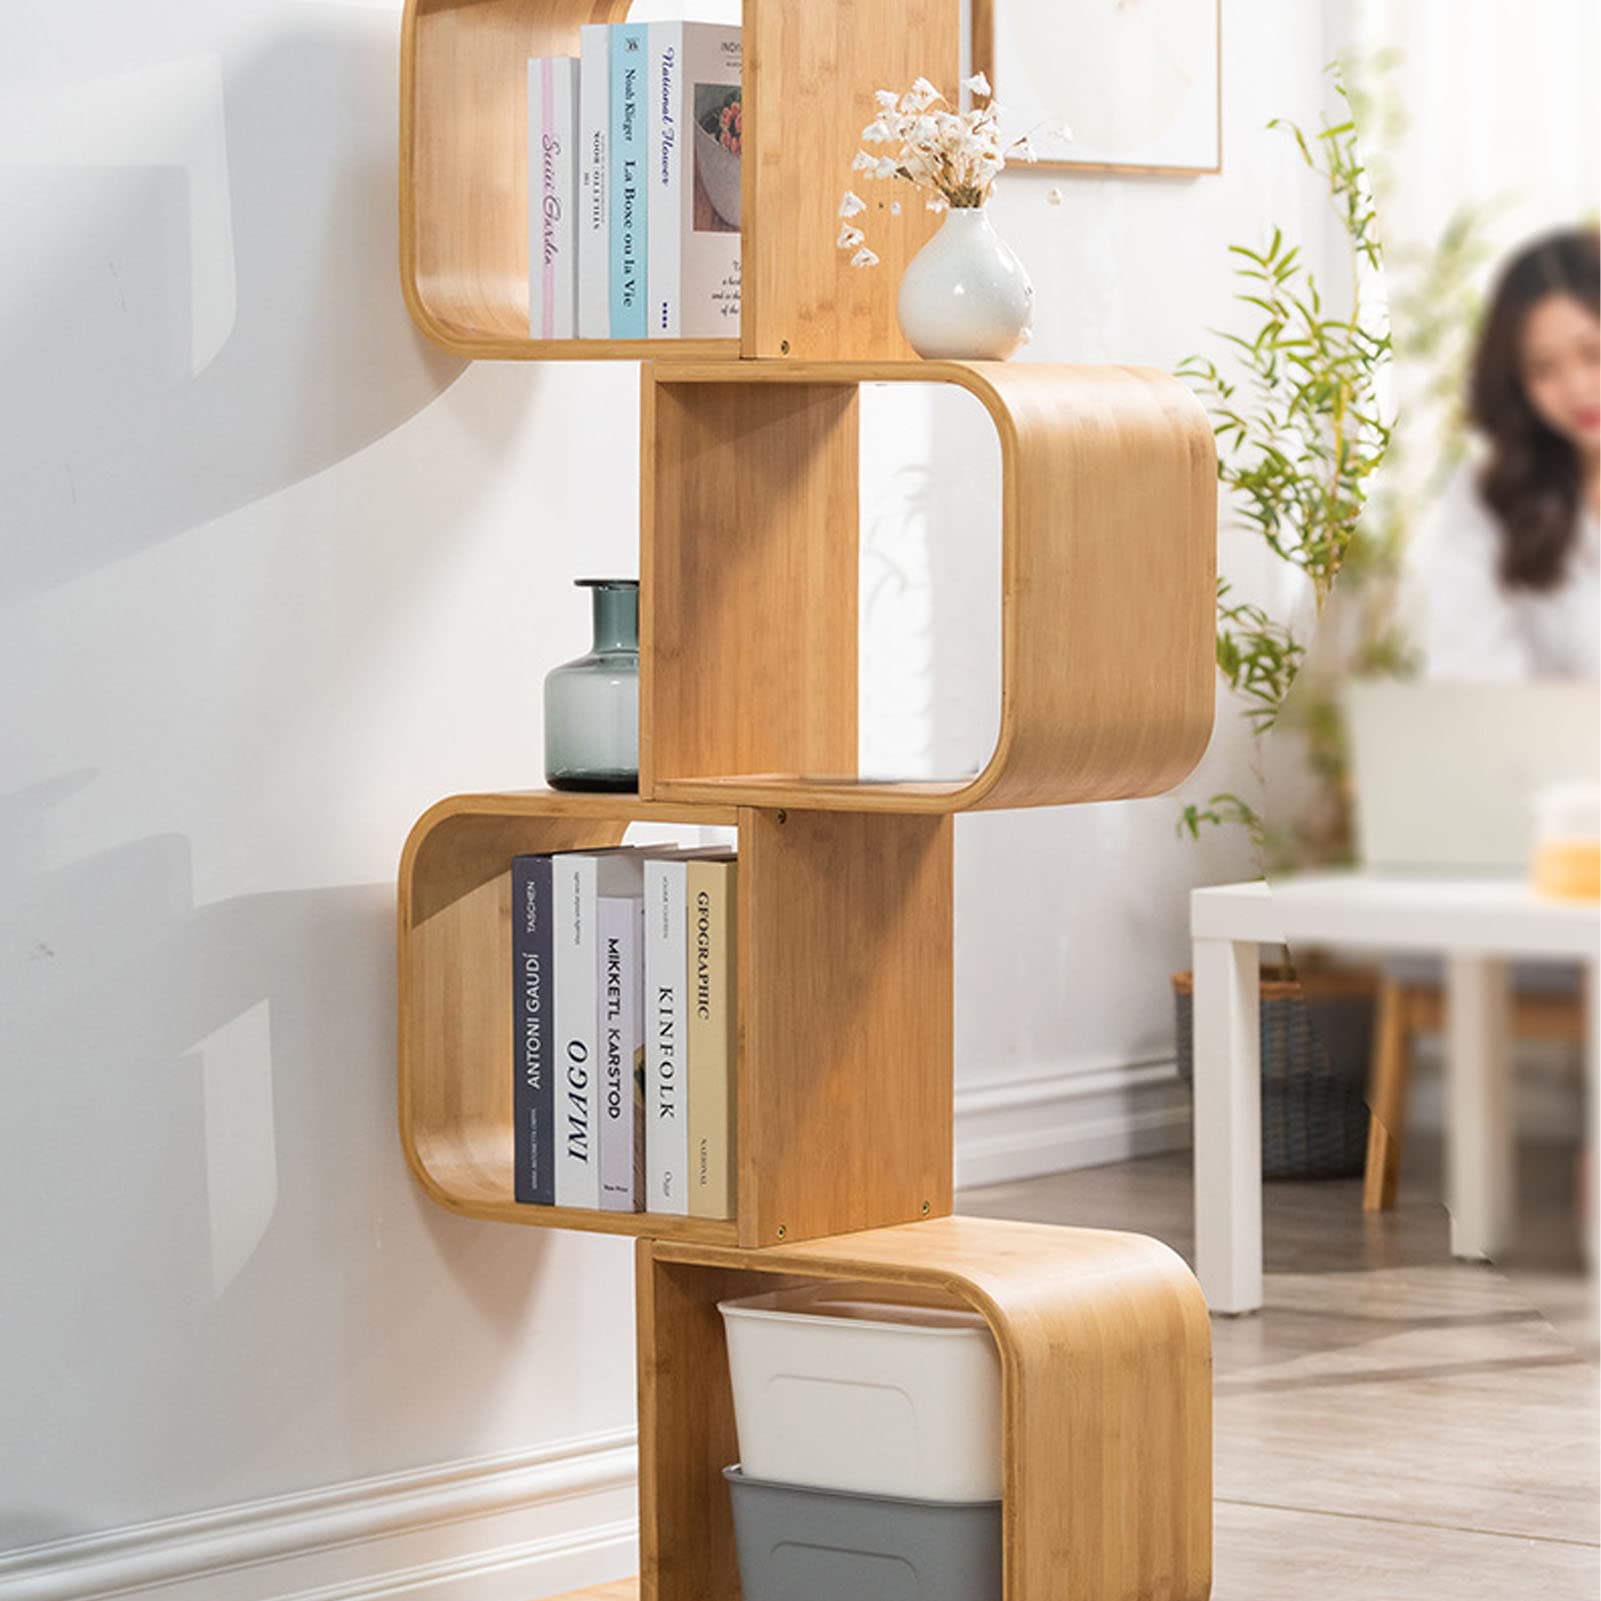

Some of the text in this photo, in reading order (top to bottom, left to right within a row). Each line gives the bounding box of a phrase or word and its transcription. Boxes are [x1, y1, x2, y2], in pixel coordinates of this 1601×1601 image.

[625, 68, 635, 100] Noah
[661, 47, 675, 185] National Flower
[543, 195, 561, 265] Garden
[624, 160, 636, 307] La Boxe ou la Vie
[526, 881, 536, 934] TASCHEN
[522, 952, 540, 1089] ANTONI GAUDÍ
[608, 938, 621, 1119] MIKKETL KARSTOD
[659, 987, 674, 1118] KINFOLK
[567, 1040, 588, 1163] IMAGO
